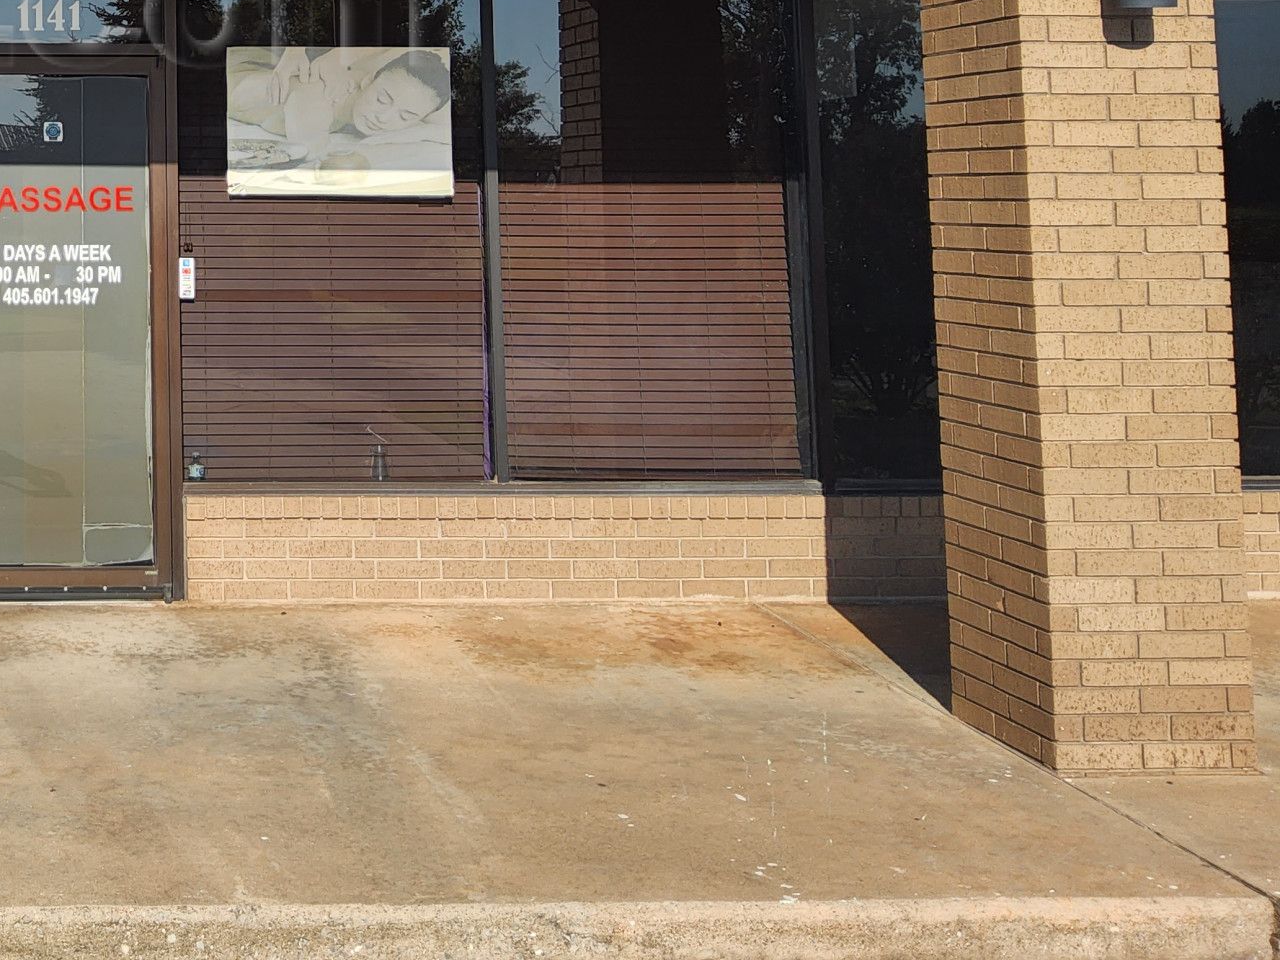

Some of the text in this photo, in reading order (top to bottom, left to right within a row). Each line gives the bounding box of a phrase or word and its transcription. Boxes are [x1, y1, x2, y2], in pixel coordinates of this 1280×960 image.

[17, 0, 81, 32] 1141
[3, 244, 46, 262] DAYS
[48, 244, 61, 262] A
[63, 244, 112, 262] WEEK
[14, 265, 40, 283] AM
[97, 265, 122, 283] PM
[2, 287, 100, 305] 405.601.1947
